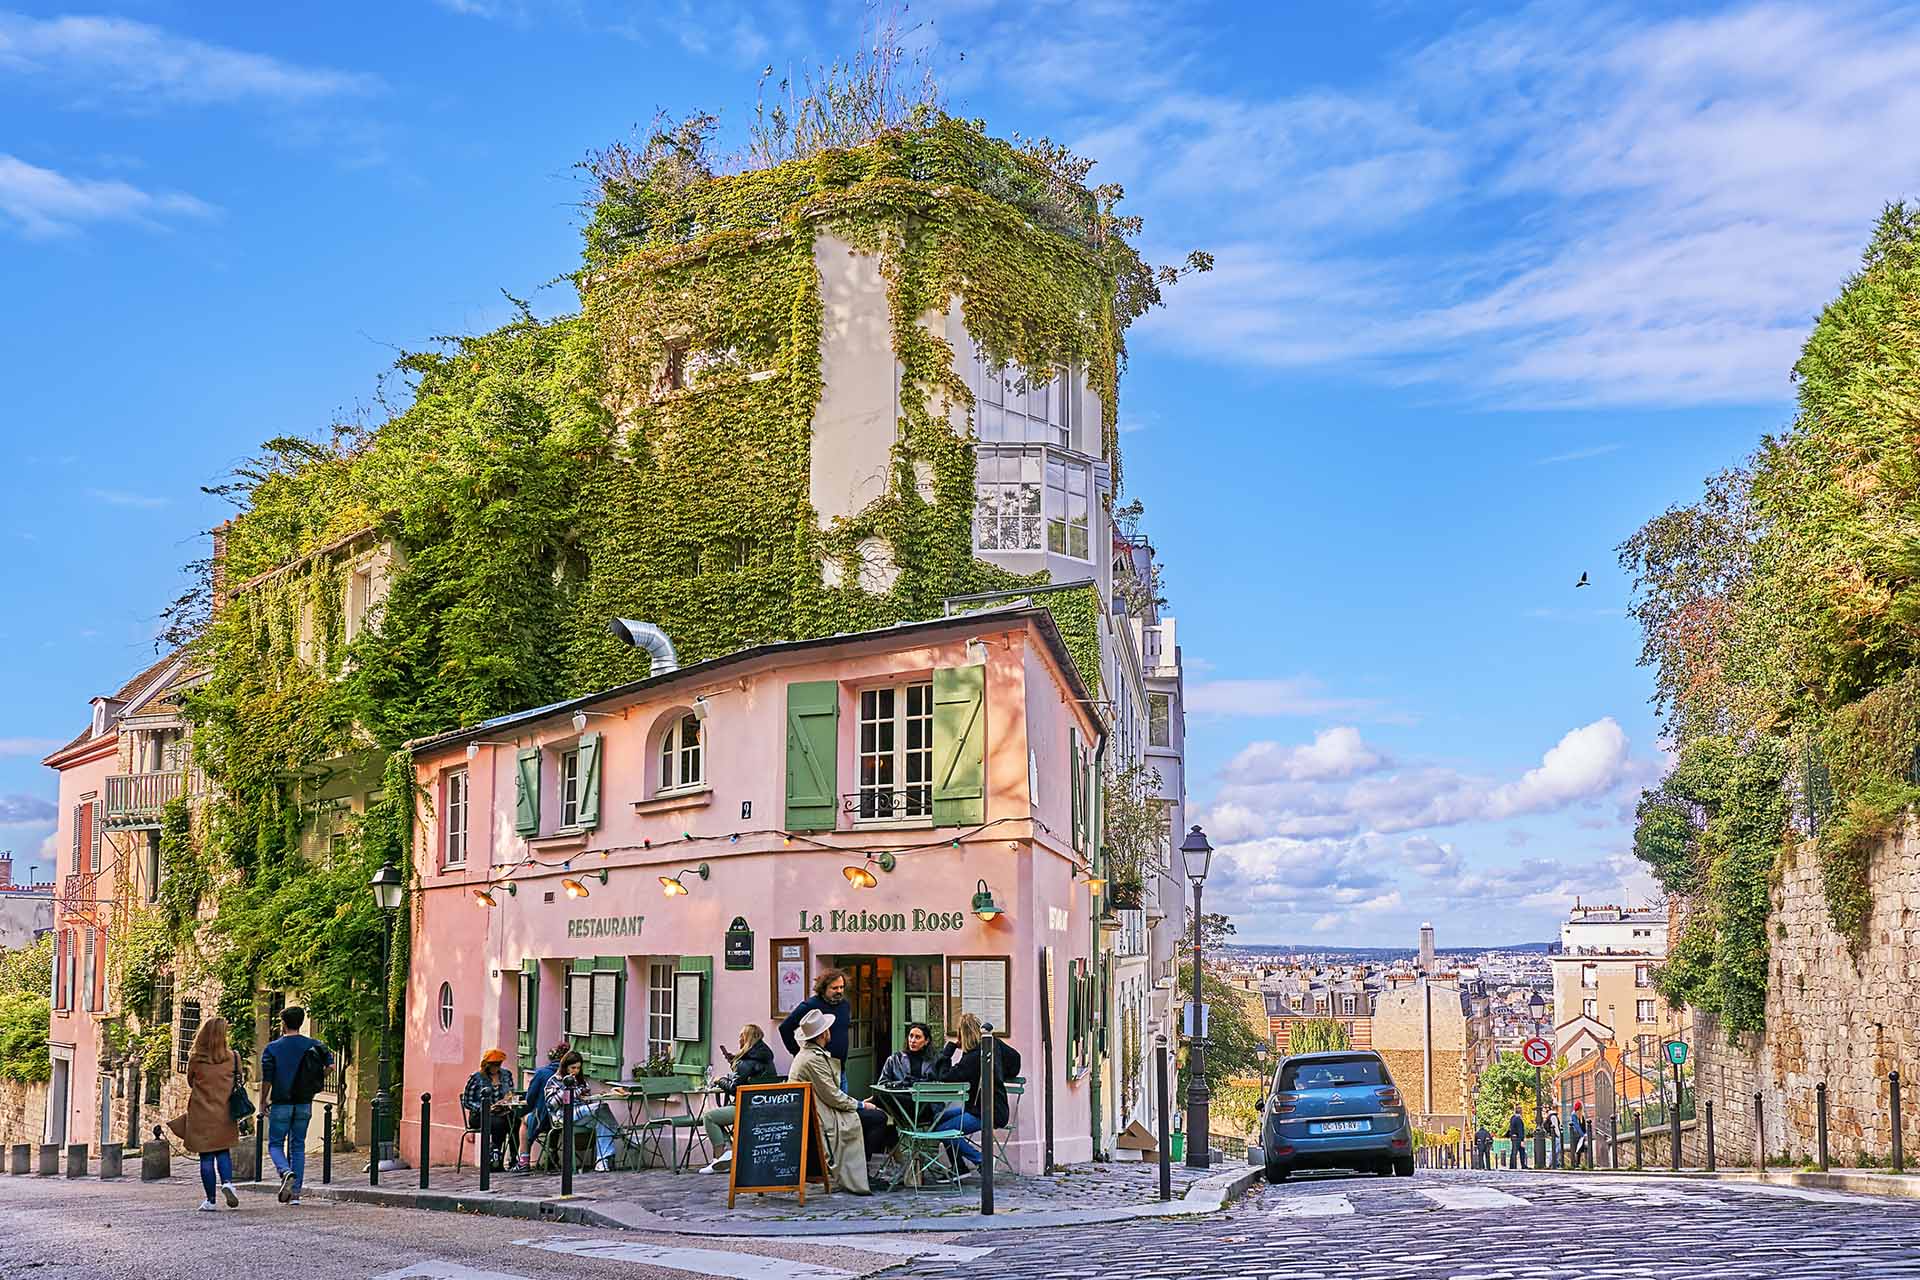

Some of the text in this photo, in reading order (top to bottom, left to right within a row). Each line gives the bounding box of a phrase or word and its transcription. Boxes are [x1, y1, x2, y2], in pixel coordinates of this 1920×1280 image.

[743, 802, 750, 818] 2
[567, 916, 645, 938] RESTAURANT
[799, 908, 964, 933] La Maison Rose
[752, 1093, 800, 1104] OUVERT
